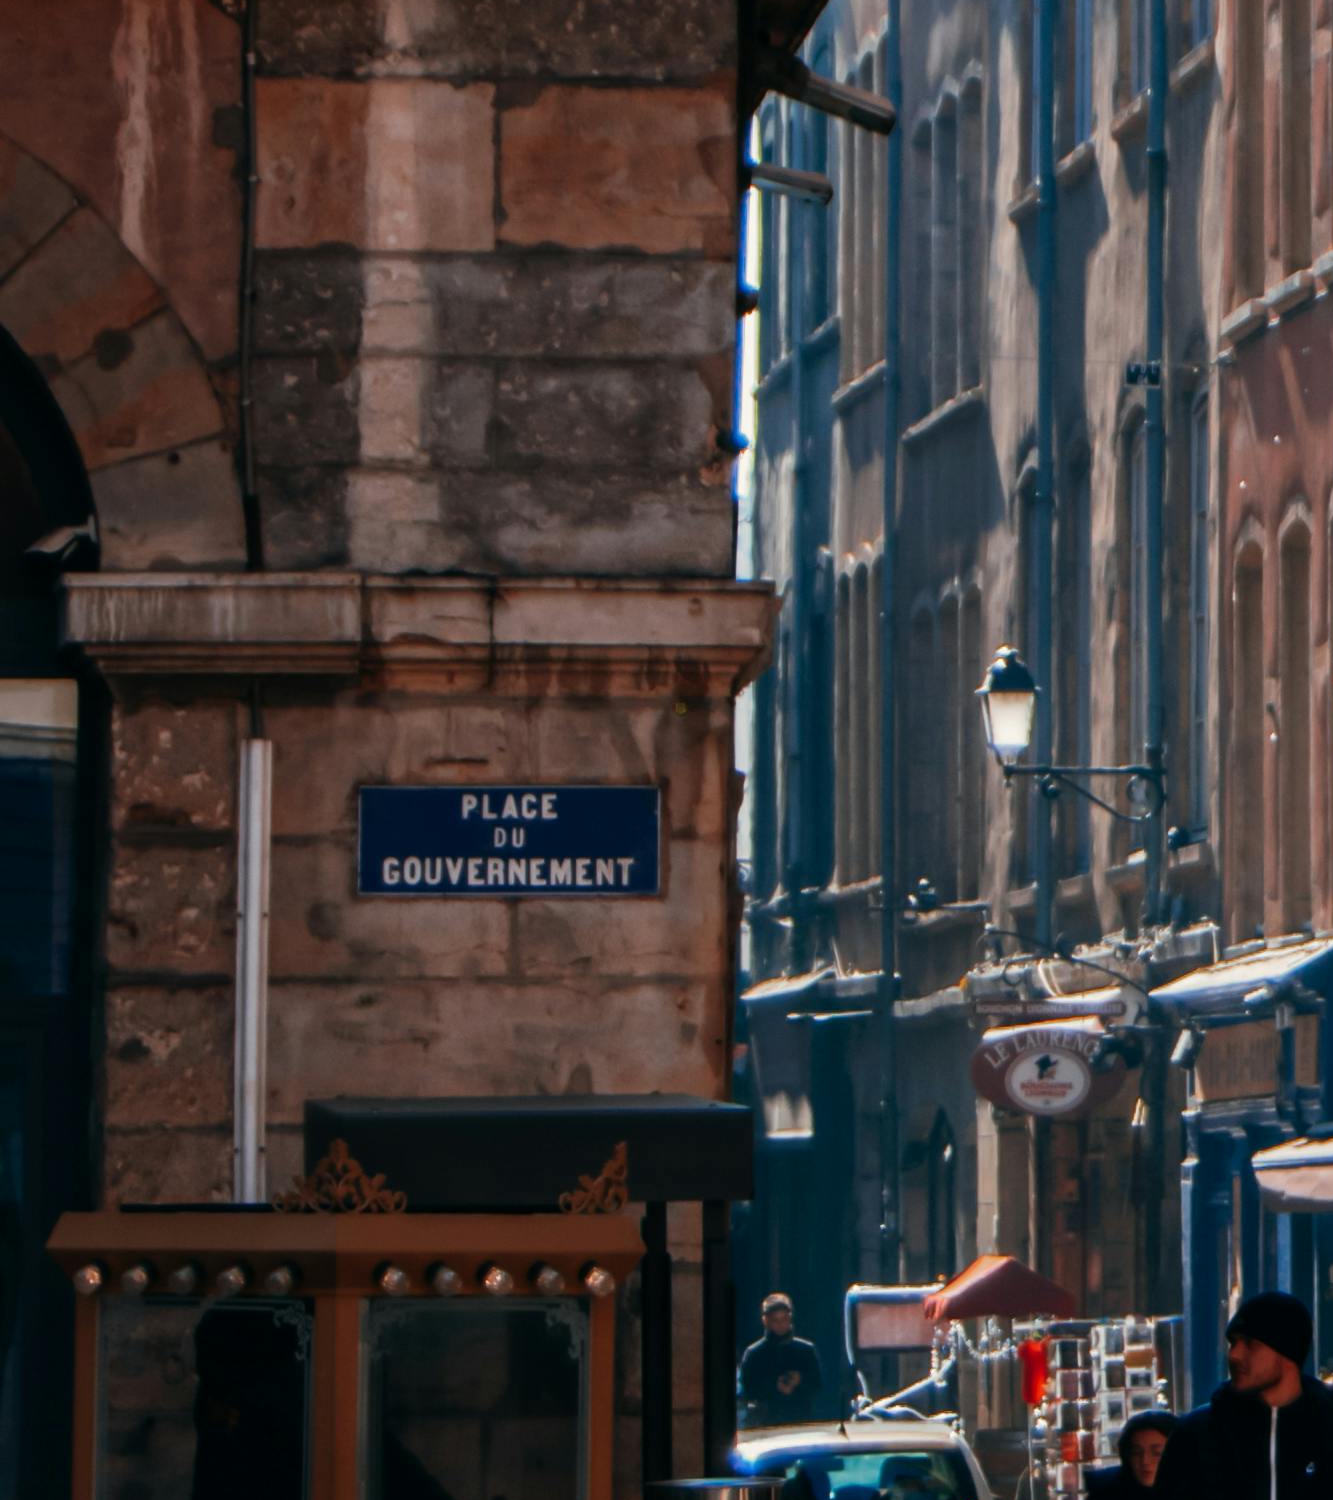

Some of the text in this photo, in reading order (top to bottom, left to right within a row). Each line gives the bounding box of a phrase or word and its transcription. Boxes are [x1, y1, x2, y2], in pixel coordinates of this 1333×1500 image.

[461, 794, 558, 819] PLACE
[494, 827, 524, 848] DU
[382, 857, 634, 886] GOUVERNEMENT
[984, 1046, 1010, 1069] LE
